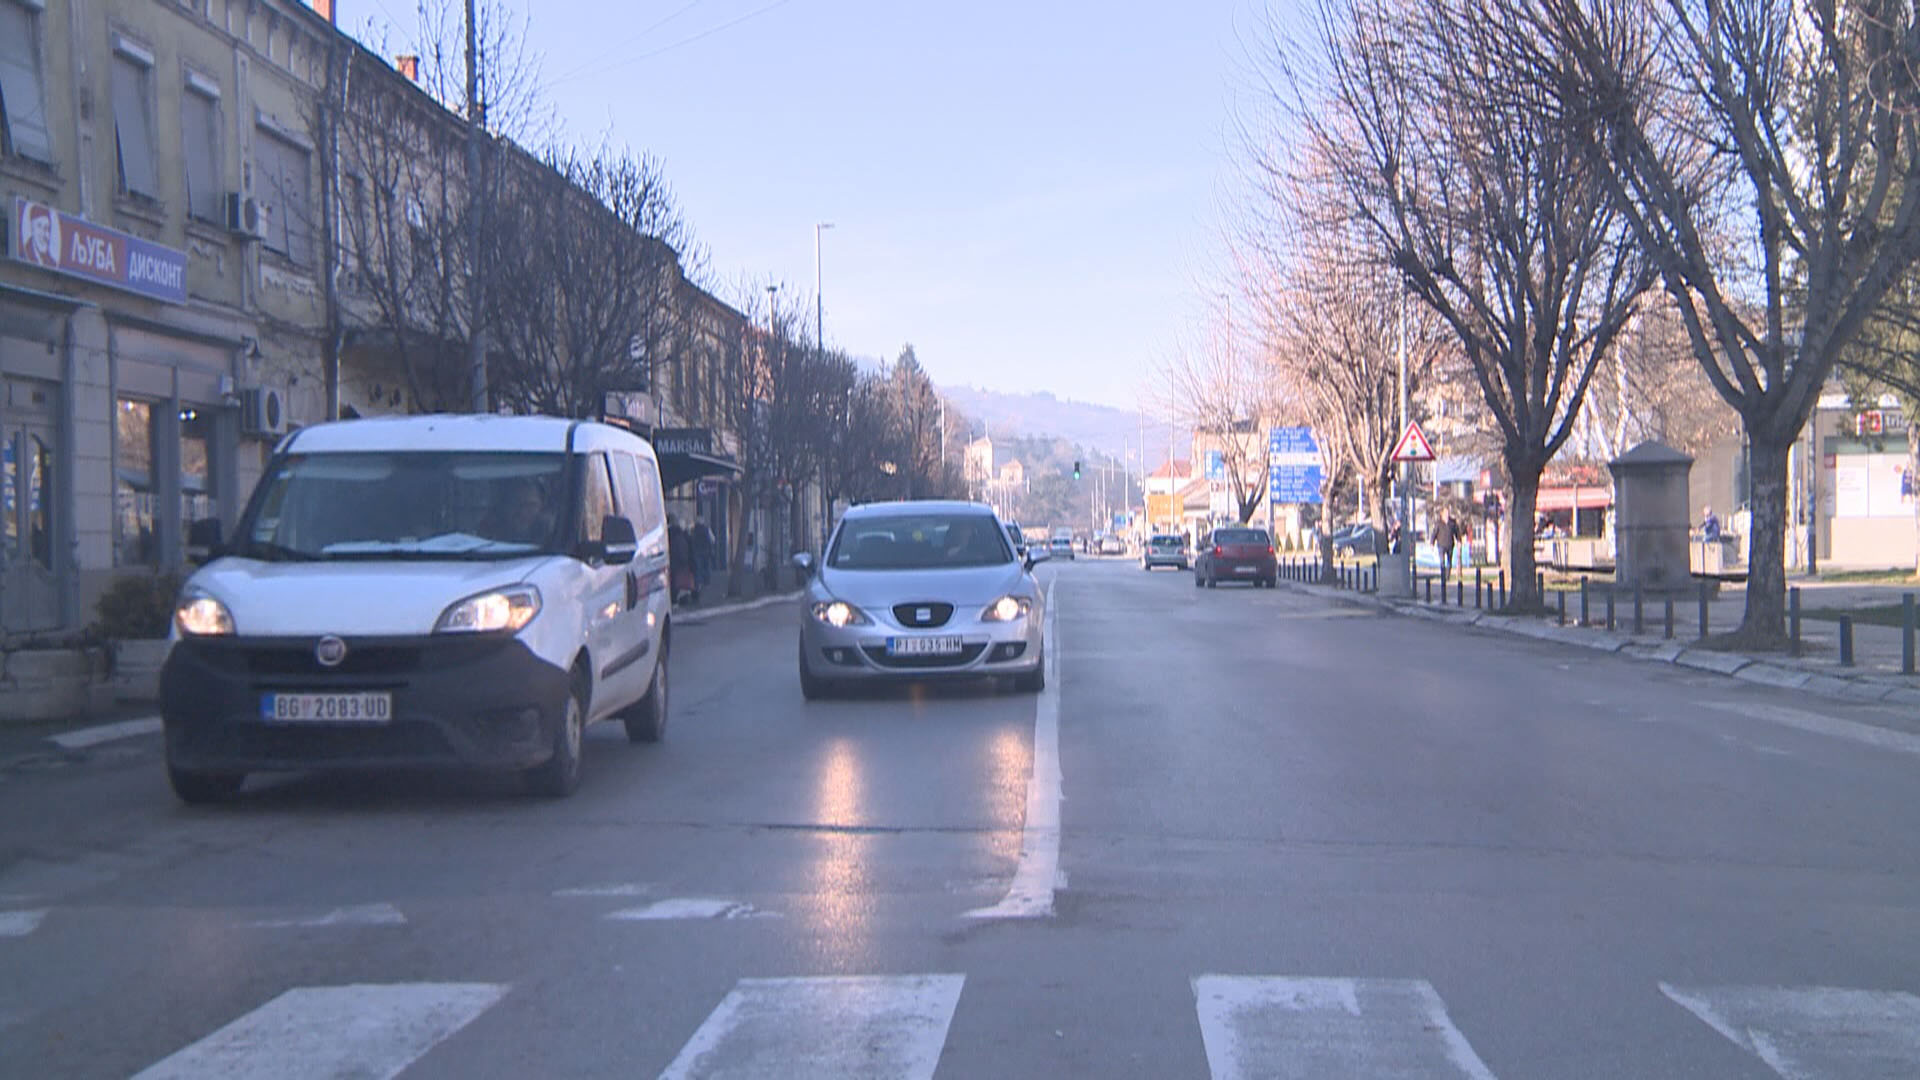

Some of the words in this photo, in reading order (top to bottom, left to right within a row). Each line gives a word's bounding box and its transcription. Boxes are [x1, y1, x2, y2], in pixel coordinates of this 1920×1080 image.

[71, 231, 117, 274] ЉУБА
[129, 251, 183, 289] ДИСКОНТ
[278, 697, 299, 717] BG
